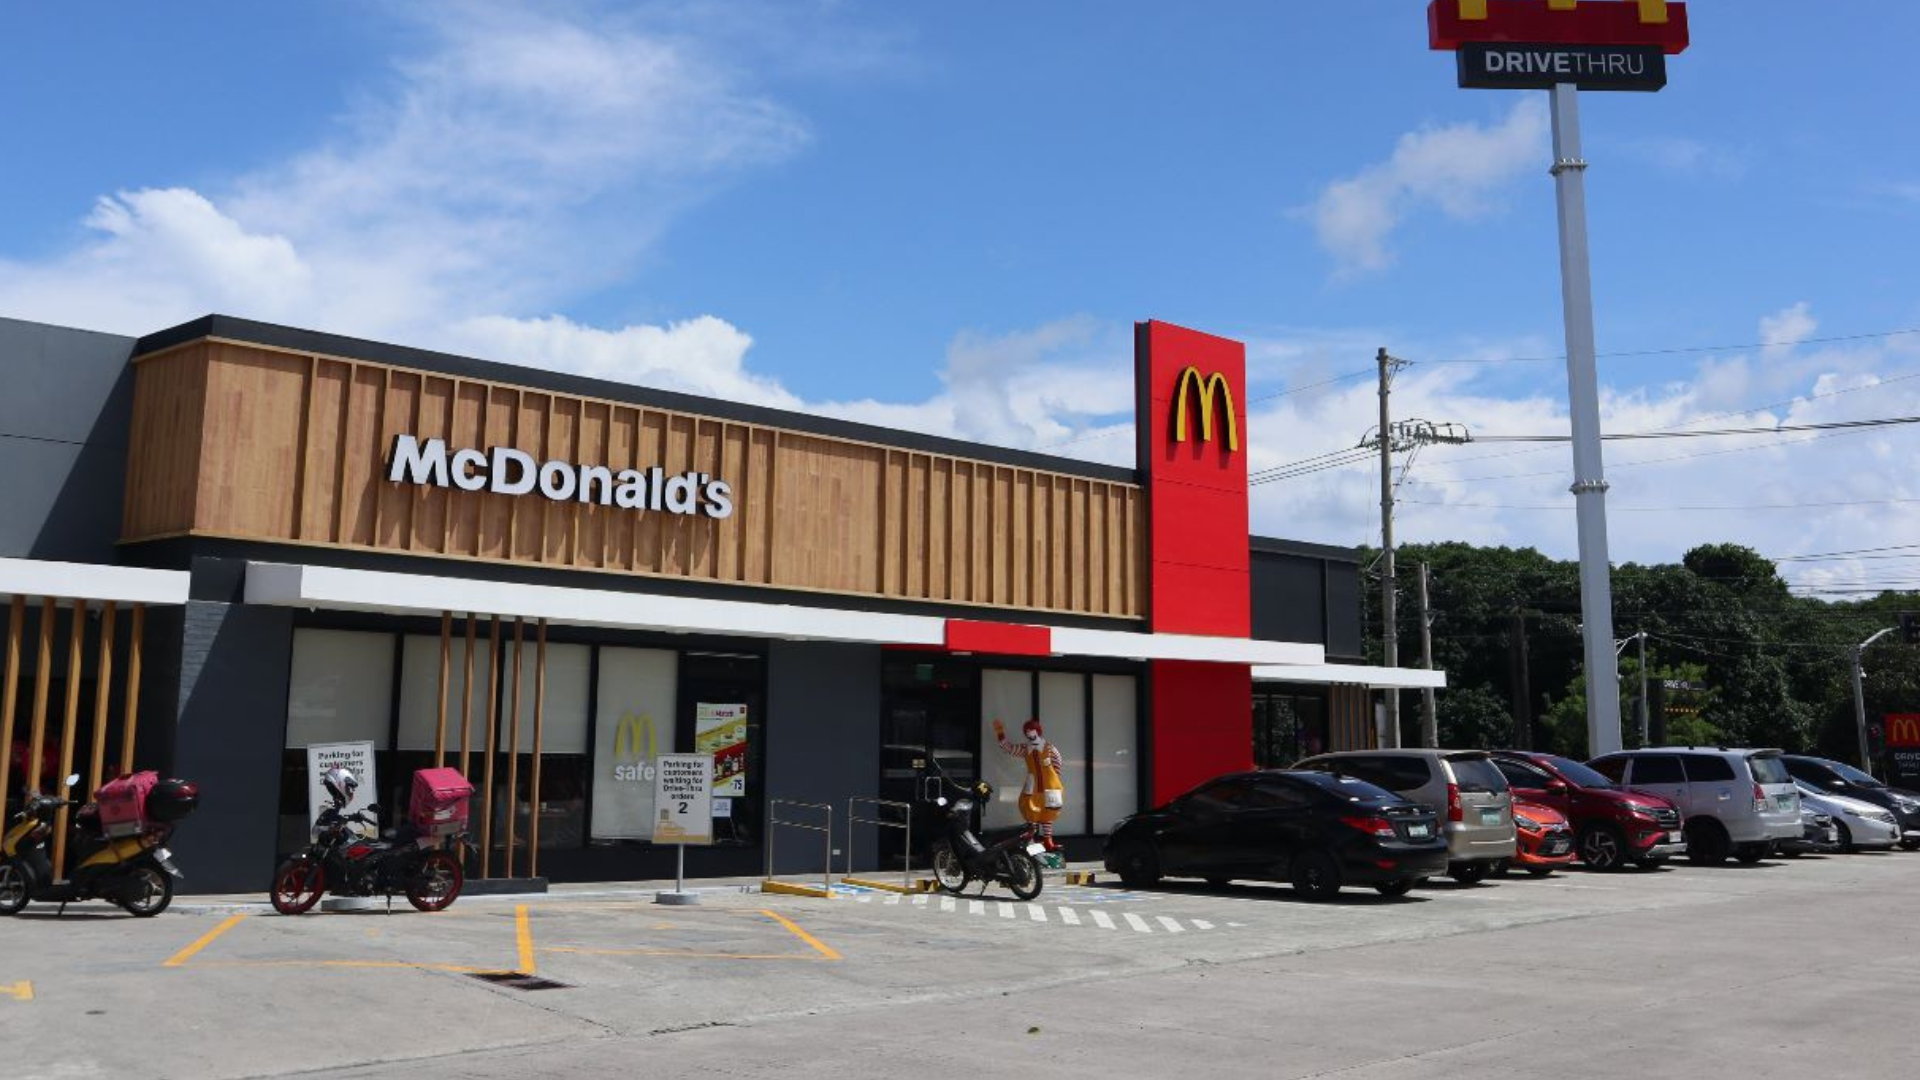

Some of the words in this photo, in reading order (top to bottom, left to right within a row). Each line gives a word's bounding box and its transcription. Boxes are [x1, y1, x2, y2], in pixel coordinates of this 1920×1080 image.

[388, 434, 734, 519] McDonald's
[318, 751, 351, 760] Parking
[663, 760, 692, 770] Parking
[693, 760, 704, 768] for
[614, 762, 656, 781] safe
[663, 769, 703, 777] customers
[663, 776, 692, 785] waiting
[692, 776, 703, 785] for
[670, 792, 695, 800] orders
[678, 801, 688, 814] 2
